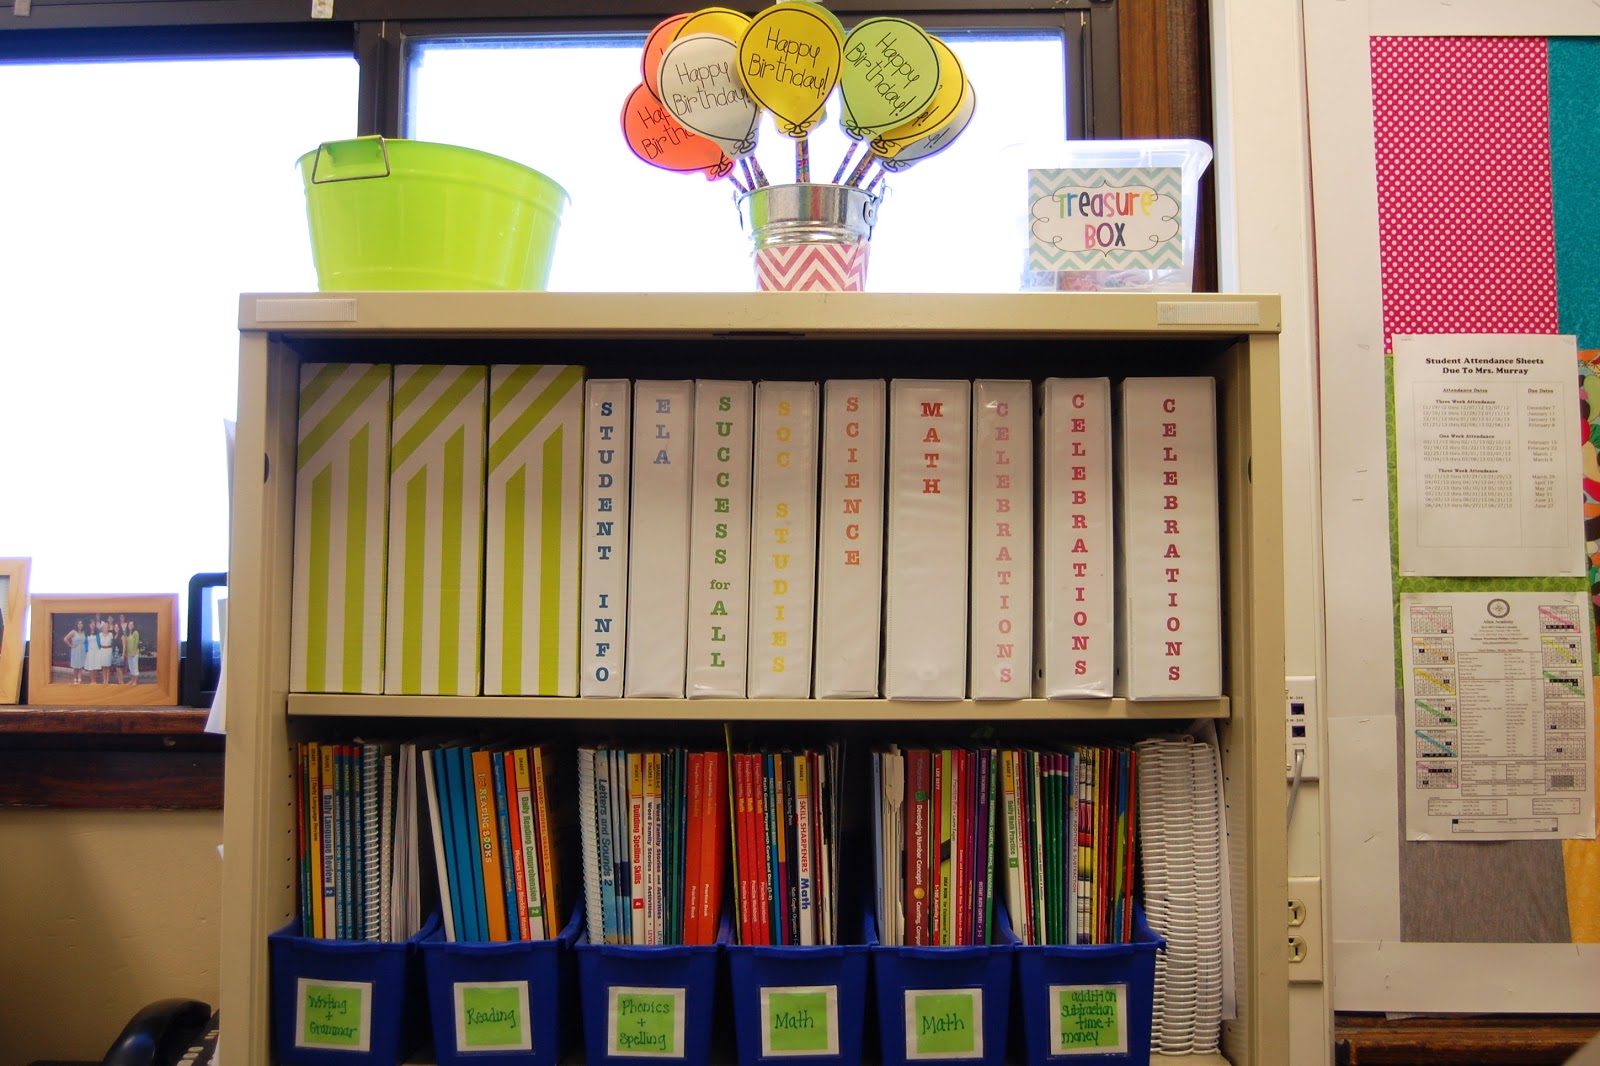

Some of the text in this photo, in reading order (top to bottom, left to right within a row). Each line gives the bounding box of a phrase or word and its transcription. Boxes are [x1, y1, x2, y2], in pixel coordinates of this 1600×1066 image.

[766, 26, 820, 68] Happy
[876, 32, 920, 89] Happy
[676, 62, 730, 88] Happy
[748, 53, 830, 99] Birthday!
[846, 42, 916, 116] Birthday!
[1084, 222, 1126, 248] BOX
[653, 399, 671, 465] ELA
[921, 402, 943, 494] MATH
[843, 396, 862, 565] SCIENCE
[594, 402, 614, 682] STUDENT INFO
[710, 396, 733, 667] SUCCESS for ALL
[772, 401, 791, 672] SOC STUDIES
[995, 402, 1014, 682] CELEBRATIONS
[1071, 394, 1089, 675] CELEBRATIONS
[1162, 399, 1182, 680] CELEBRATIONS
[323, 795, 332, 814] Daily
[479, 789, 489, 828] READING
[522, 796, 530, 814] Daily
[599, 779, 607, 815] Letters
[324, 816, 333, 854] Language
[482, 830, 492, 863] BOOKS
[524, 816, 533, 844] Reading
[325, 855, 333, 883] Review
[526, 846, 538, 902] Comprehension
[602, 838, 612, 876] Sounds
[801, 878, 810, 910] Math
[467, 1008, 516, 1029] Reading
[622, 1000, 669, 1016] Phonics
[774, 1010, 814, 1029] Math
[923, 1013, 964, 1034] Math
[1075, 1016, 1104, 1030] time
[1061, 1031, 1098, 1046] money
